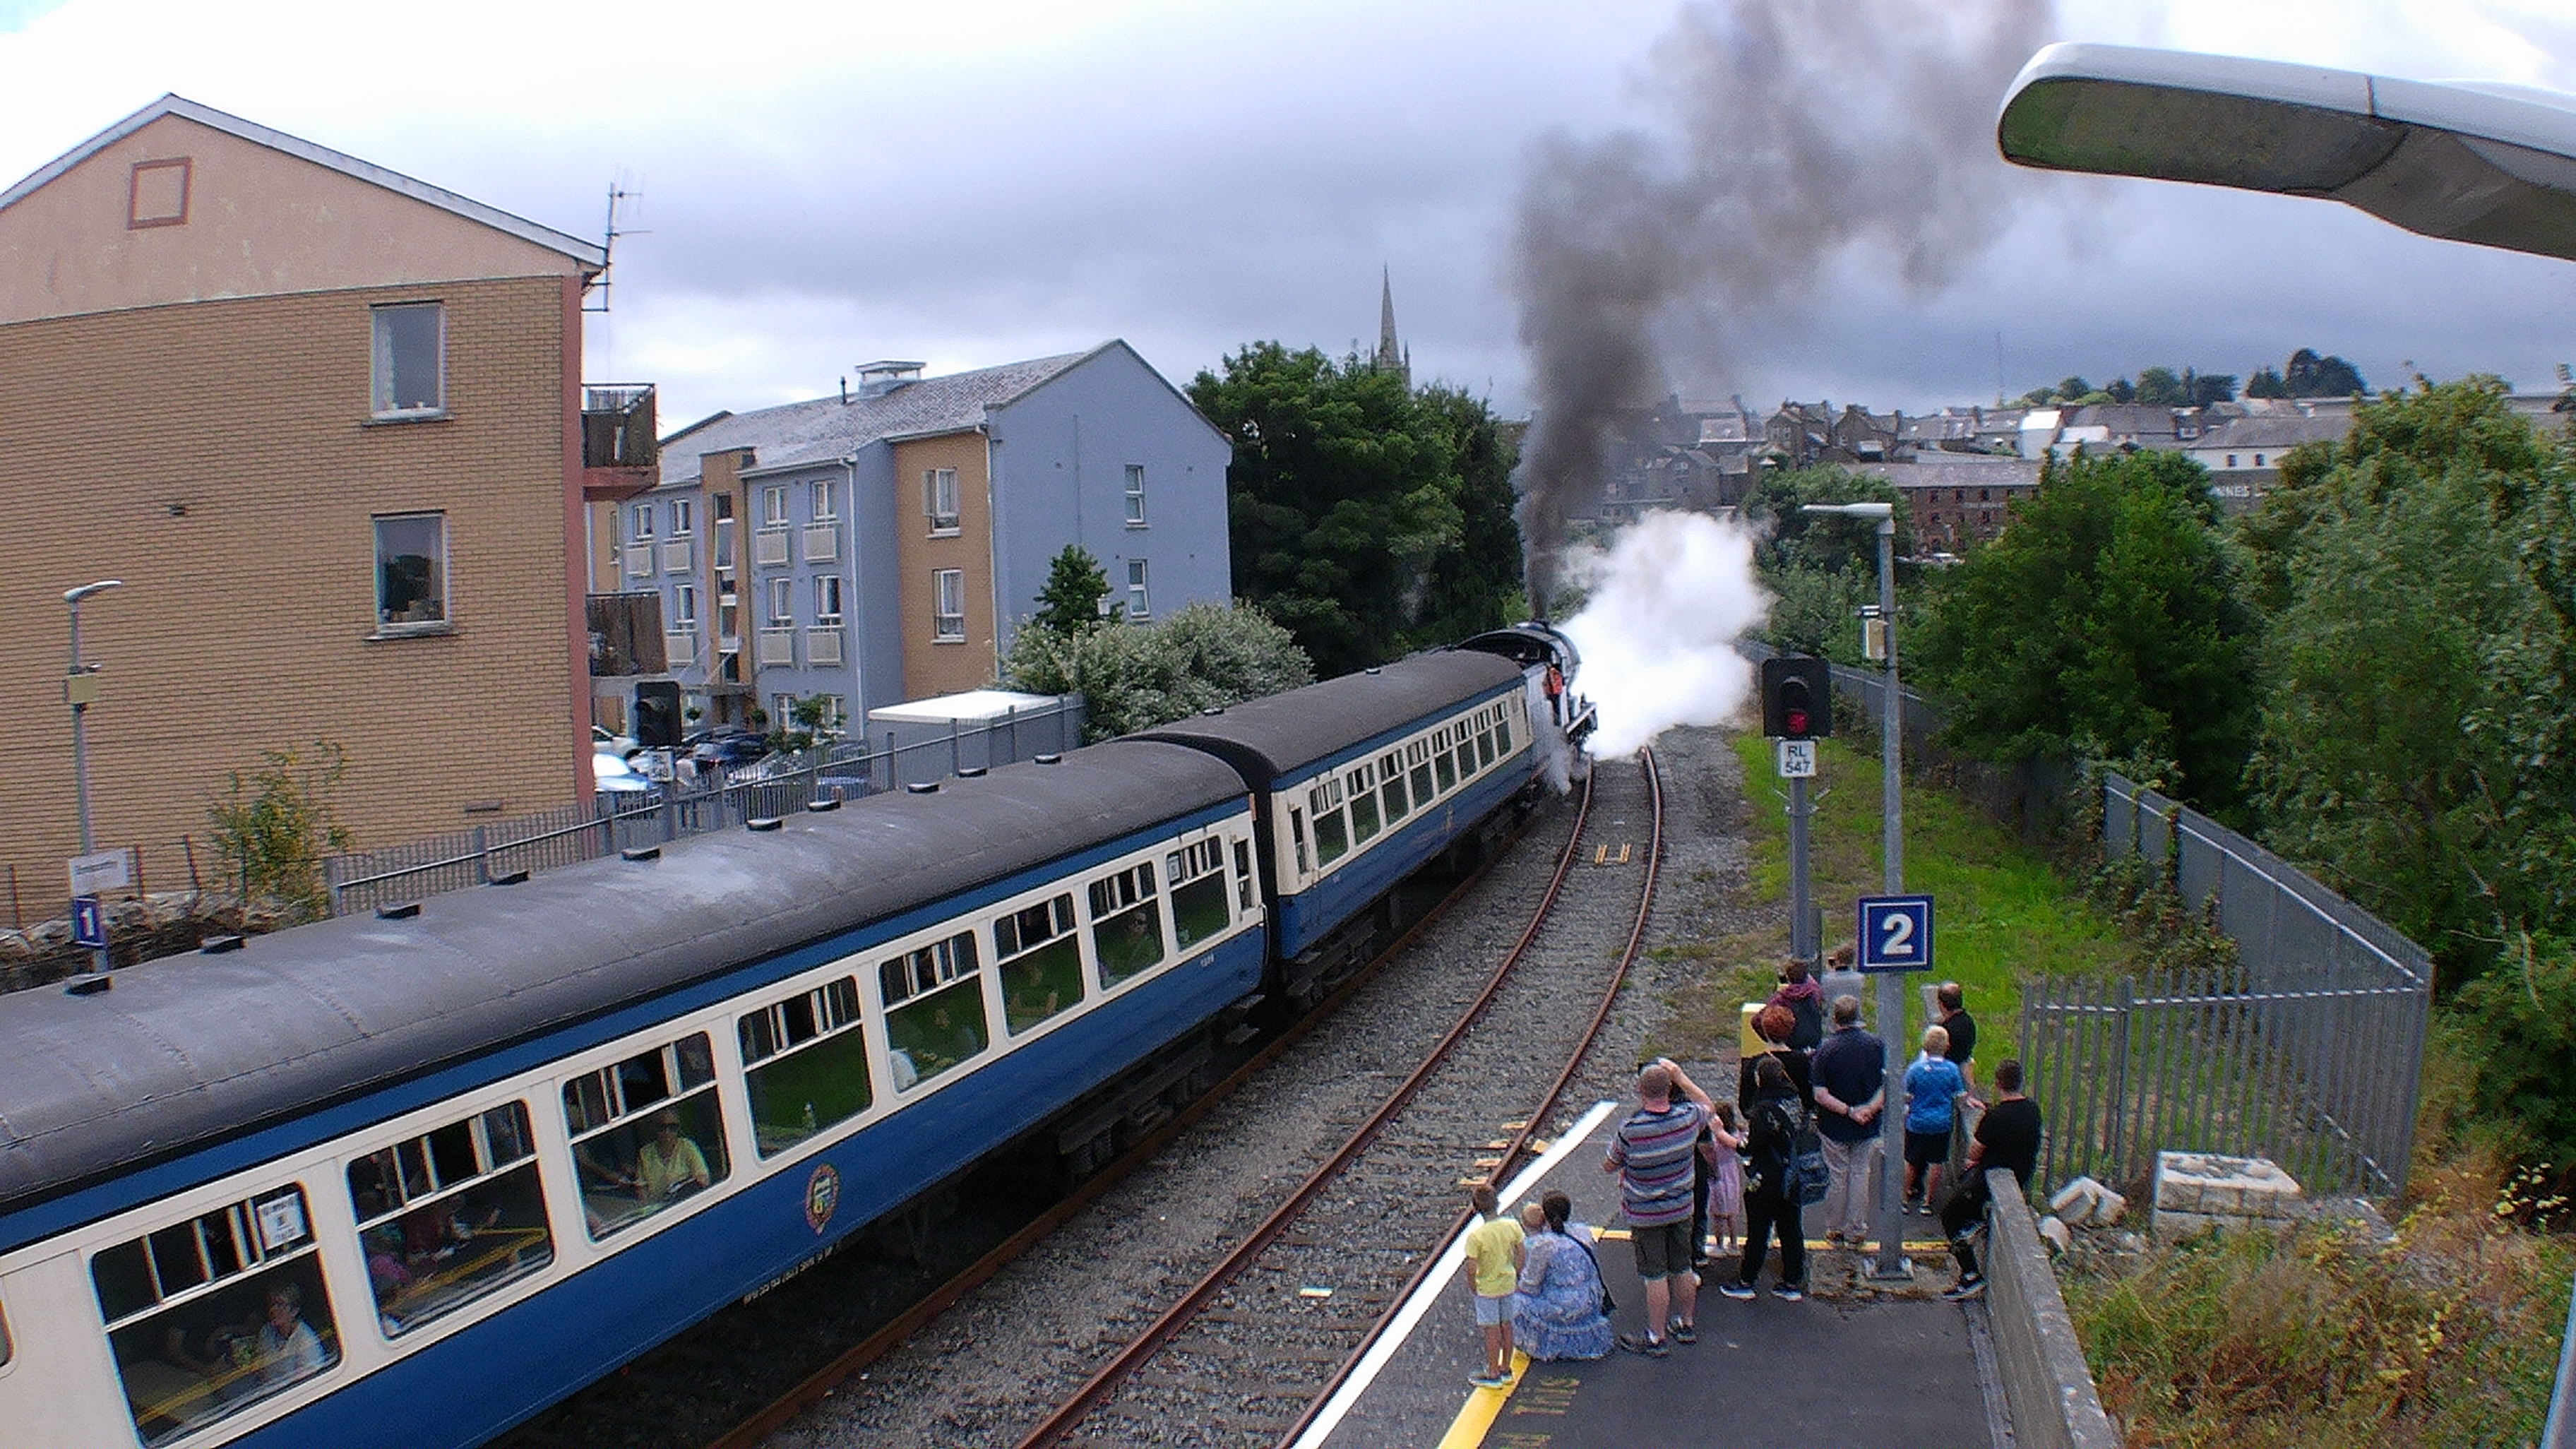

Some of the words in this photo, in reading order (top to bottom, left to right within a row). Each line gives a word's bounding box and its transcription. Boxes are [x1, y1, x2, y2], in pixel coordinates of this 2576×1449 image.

[1787, 745, 1807, 757] RL
[1786, 760, 1811, 773] 547
[80, 907, 94, 936] 1
[1883, 913, 1913, 955] 2
